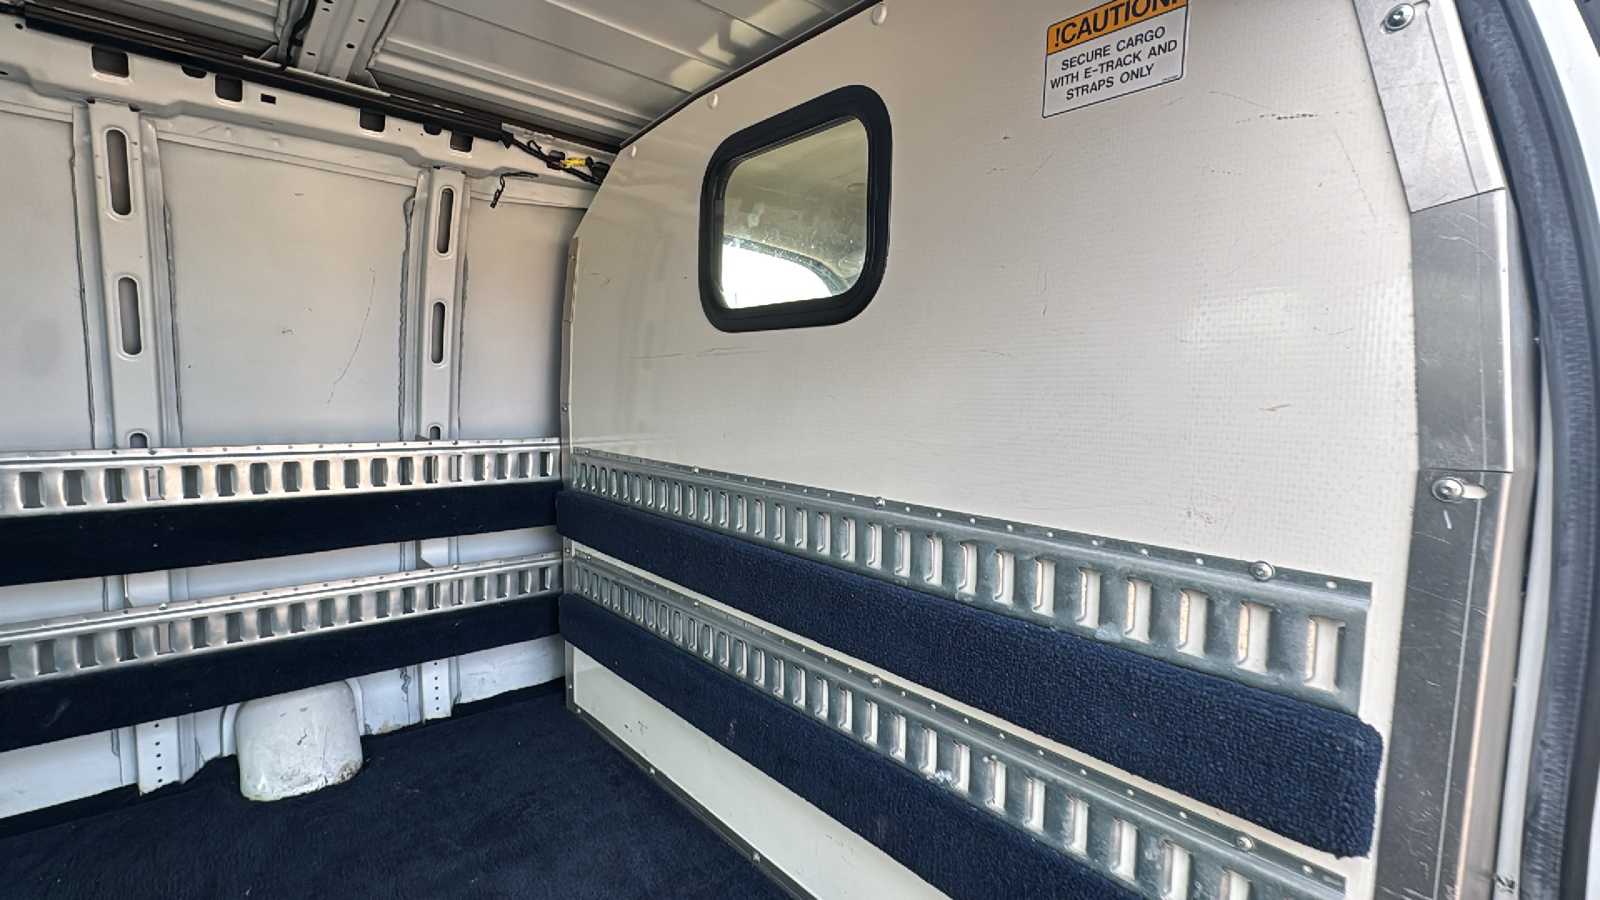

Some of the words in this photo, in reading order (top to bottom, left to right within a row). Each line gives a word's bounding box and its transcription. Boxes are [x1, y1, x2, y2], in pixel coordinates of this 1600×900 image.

[1055, 0, 1177, 47] !CAUTION
[1050, 71, 1079, 89] WITH
[1084, 50, 1142, 79] E-TRACK
[1147, 39, 1178, 59] AND
[1061, 45, 1111, 71] SECURE
[1116, 26, 1166, 52] CARGO
[1066, 76, 1114, 101] STRAPS
[1120, 63, 1155, 84] ONLY
